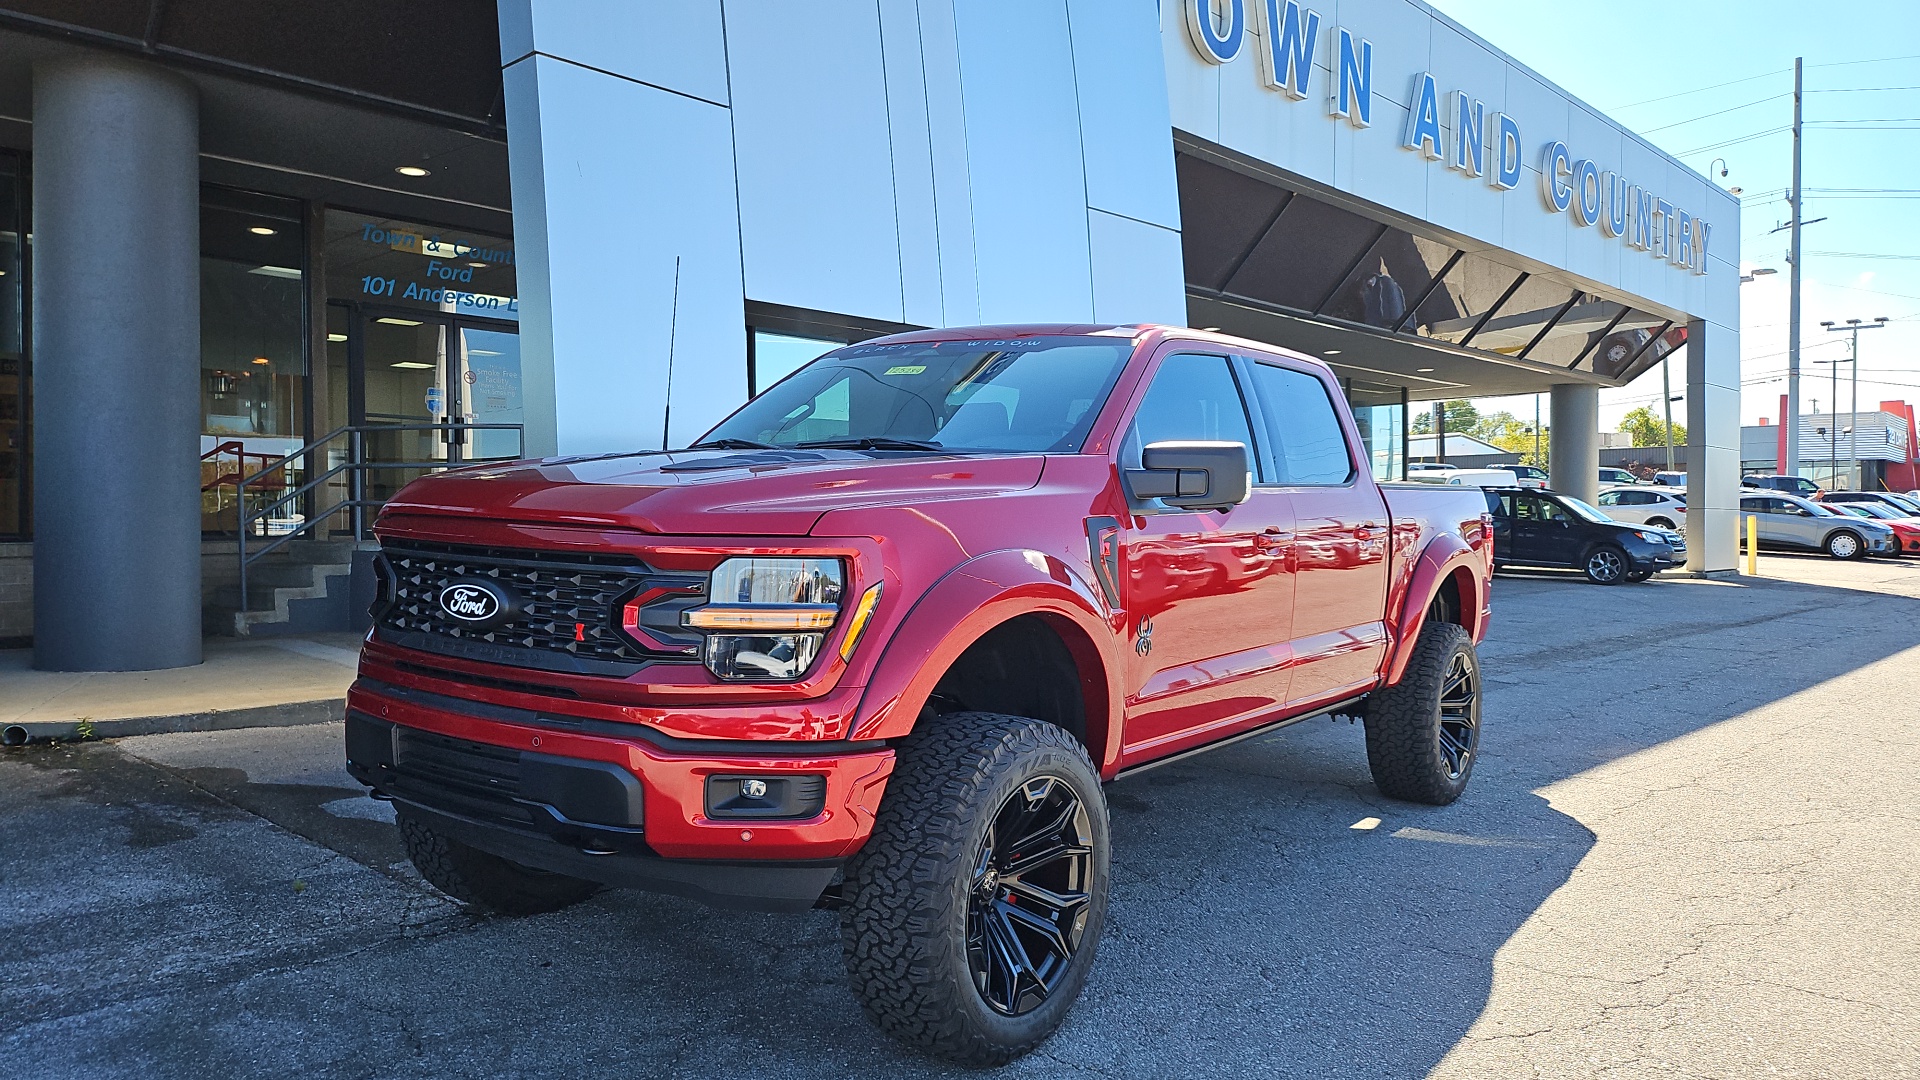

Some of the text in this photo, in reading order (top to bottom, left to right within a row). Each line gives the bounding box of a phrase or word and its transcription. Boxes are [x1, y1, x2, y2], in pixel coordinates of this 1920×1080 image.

[1156, 0, 1713, 275] OWN AND COUNTRY
[361, 223, 515, 265] Town & Count
[426, 260, 473, 283] Ford
[361, 275, 396, 297] 101
[402, 282, 498, 310] Anderson
[450, 589, 487, 615] Ford
[1020, 752, 1051, 778] T/A
